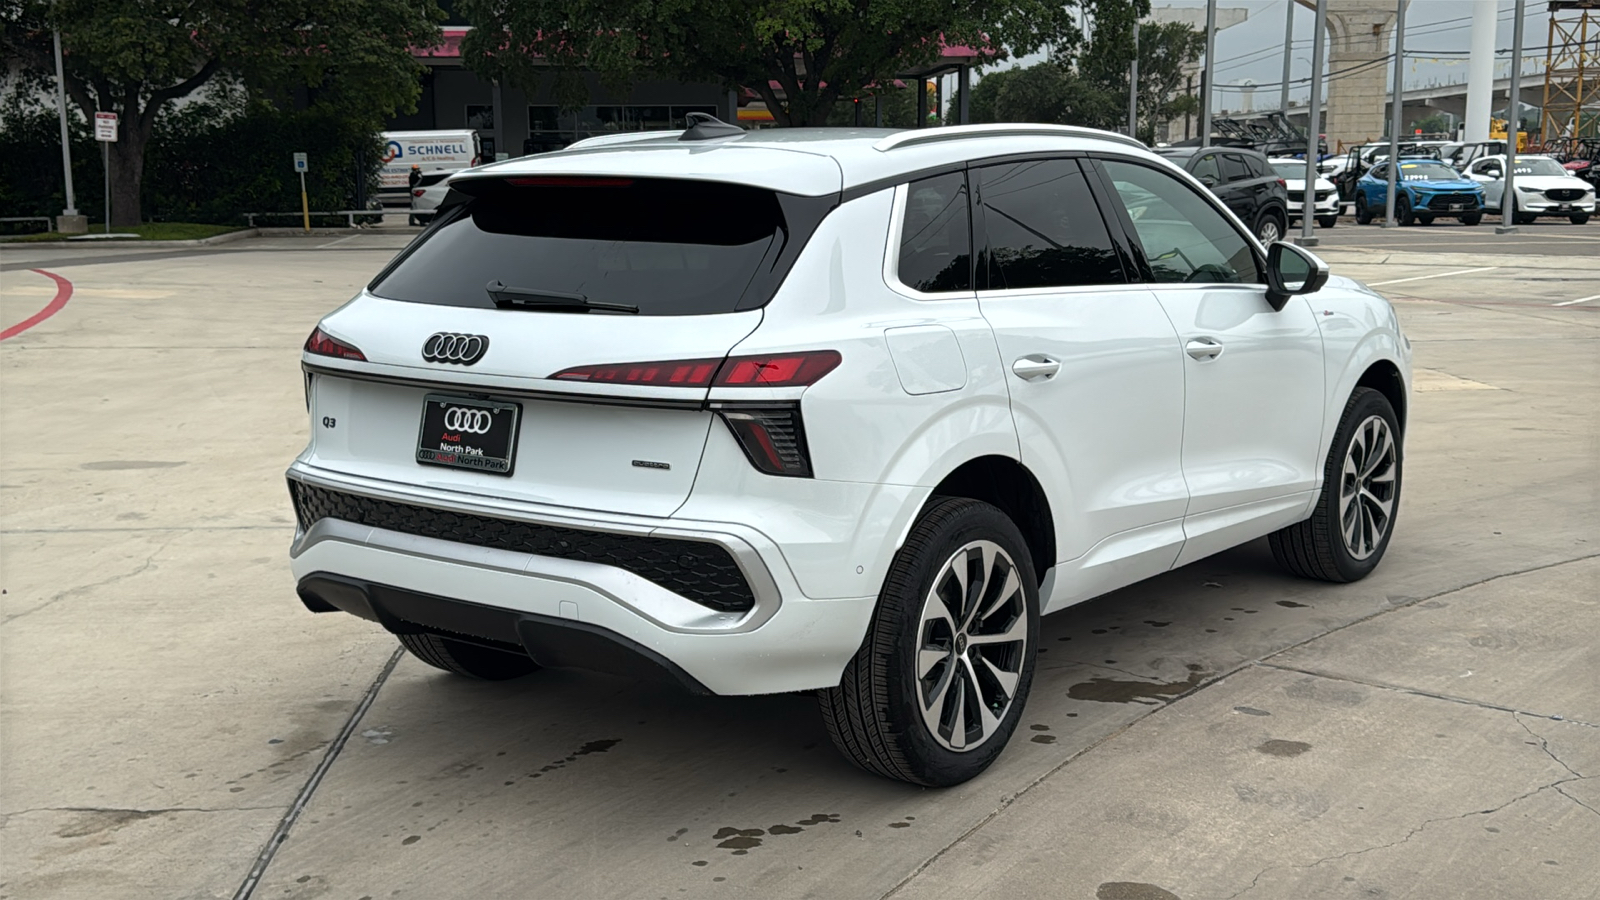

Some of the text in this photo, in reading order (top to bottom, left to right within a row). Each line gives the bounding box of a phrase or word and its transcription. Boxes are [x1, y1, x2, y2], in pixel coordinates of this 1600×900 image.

[408, 144, 467, 155] SCHNELL
[323, 416, 336, 429] Q3
[441, 432, 461, 442] Audi
[440, 442, 484, 456] North Park
[436, 453, 506, 470] Audi North Park
